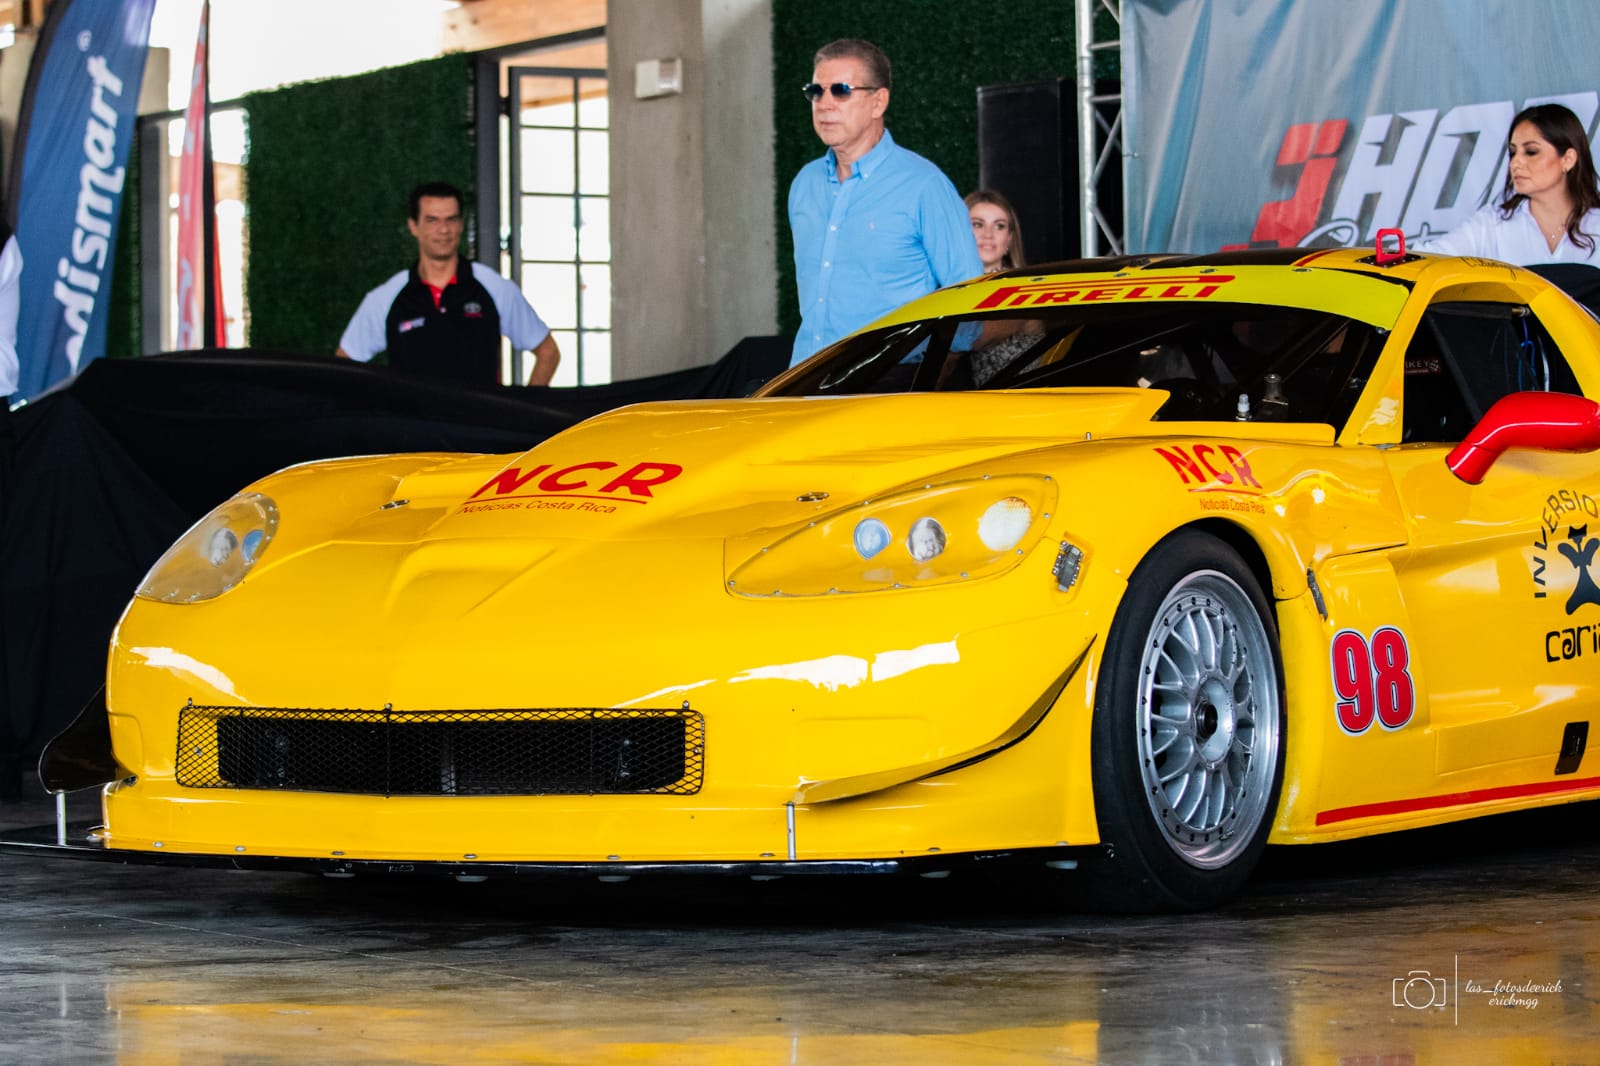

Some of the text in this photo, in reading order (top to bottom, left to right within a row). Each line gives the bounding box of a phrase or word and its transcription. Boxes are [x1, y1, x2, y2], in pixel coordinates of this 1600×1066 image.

[973, 275, 1236, 310] PIRELLI
[469, 461, 683, 498] NCR
[1153, 444, 1263, 489] NCR
[457, 500, 617, 515] Noticias Costa Rica
[1200, 498, 1265, 514] Noticias Costa Rica
[1545, 623, 1600, 663] cari
[1330, 625, 1416, 737] 98
